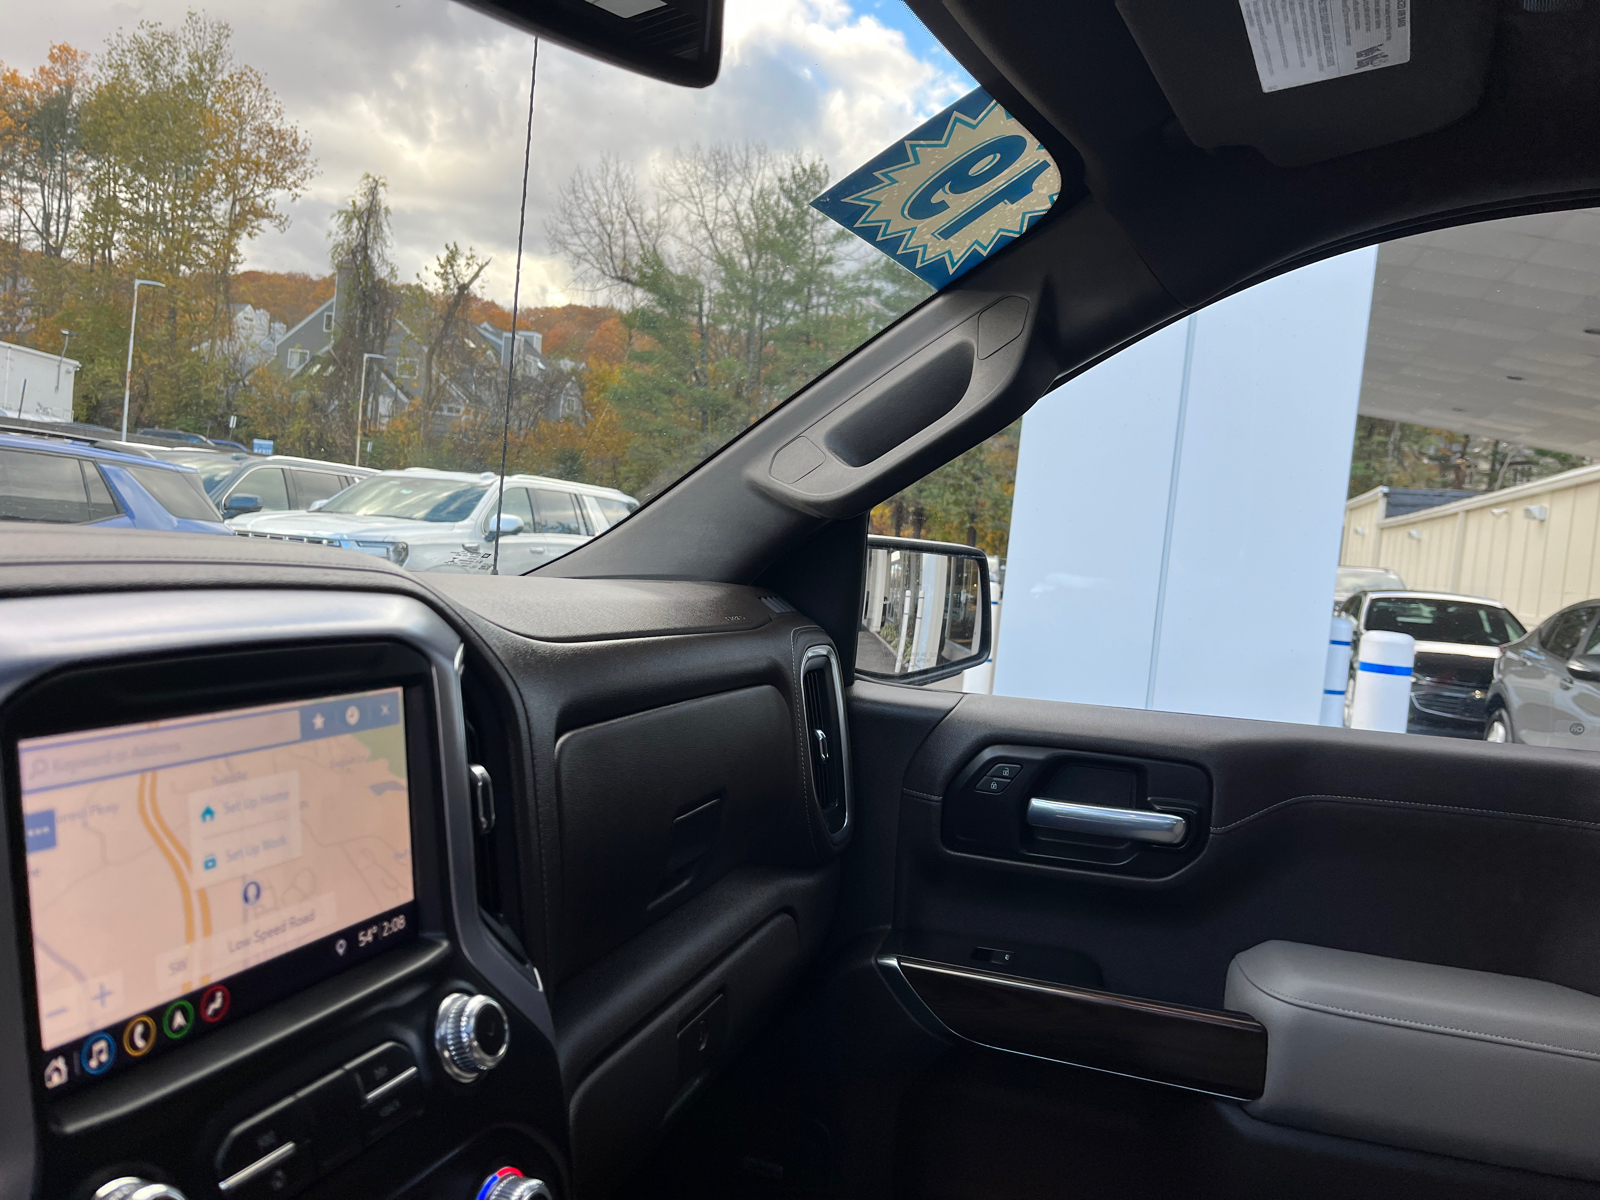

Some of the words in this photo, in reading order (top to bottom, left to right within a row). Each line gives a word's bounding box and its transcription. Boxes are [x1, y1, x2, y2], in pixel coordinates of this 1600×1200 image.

[227, 937, 252, 953] Low
[254, 922, 287, 944] Speed
[289, 908, 315, 929] Road
[381, 914, 407, 937] 2:08
